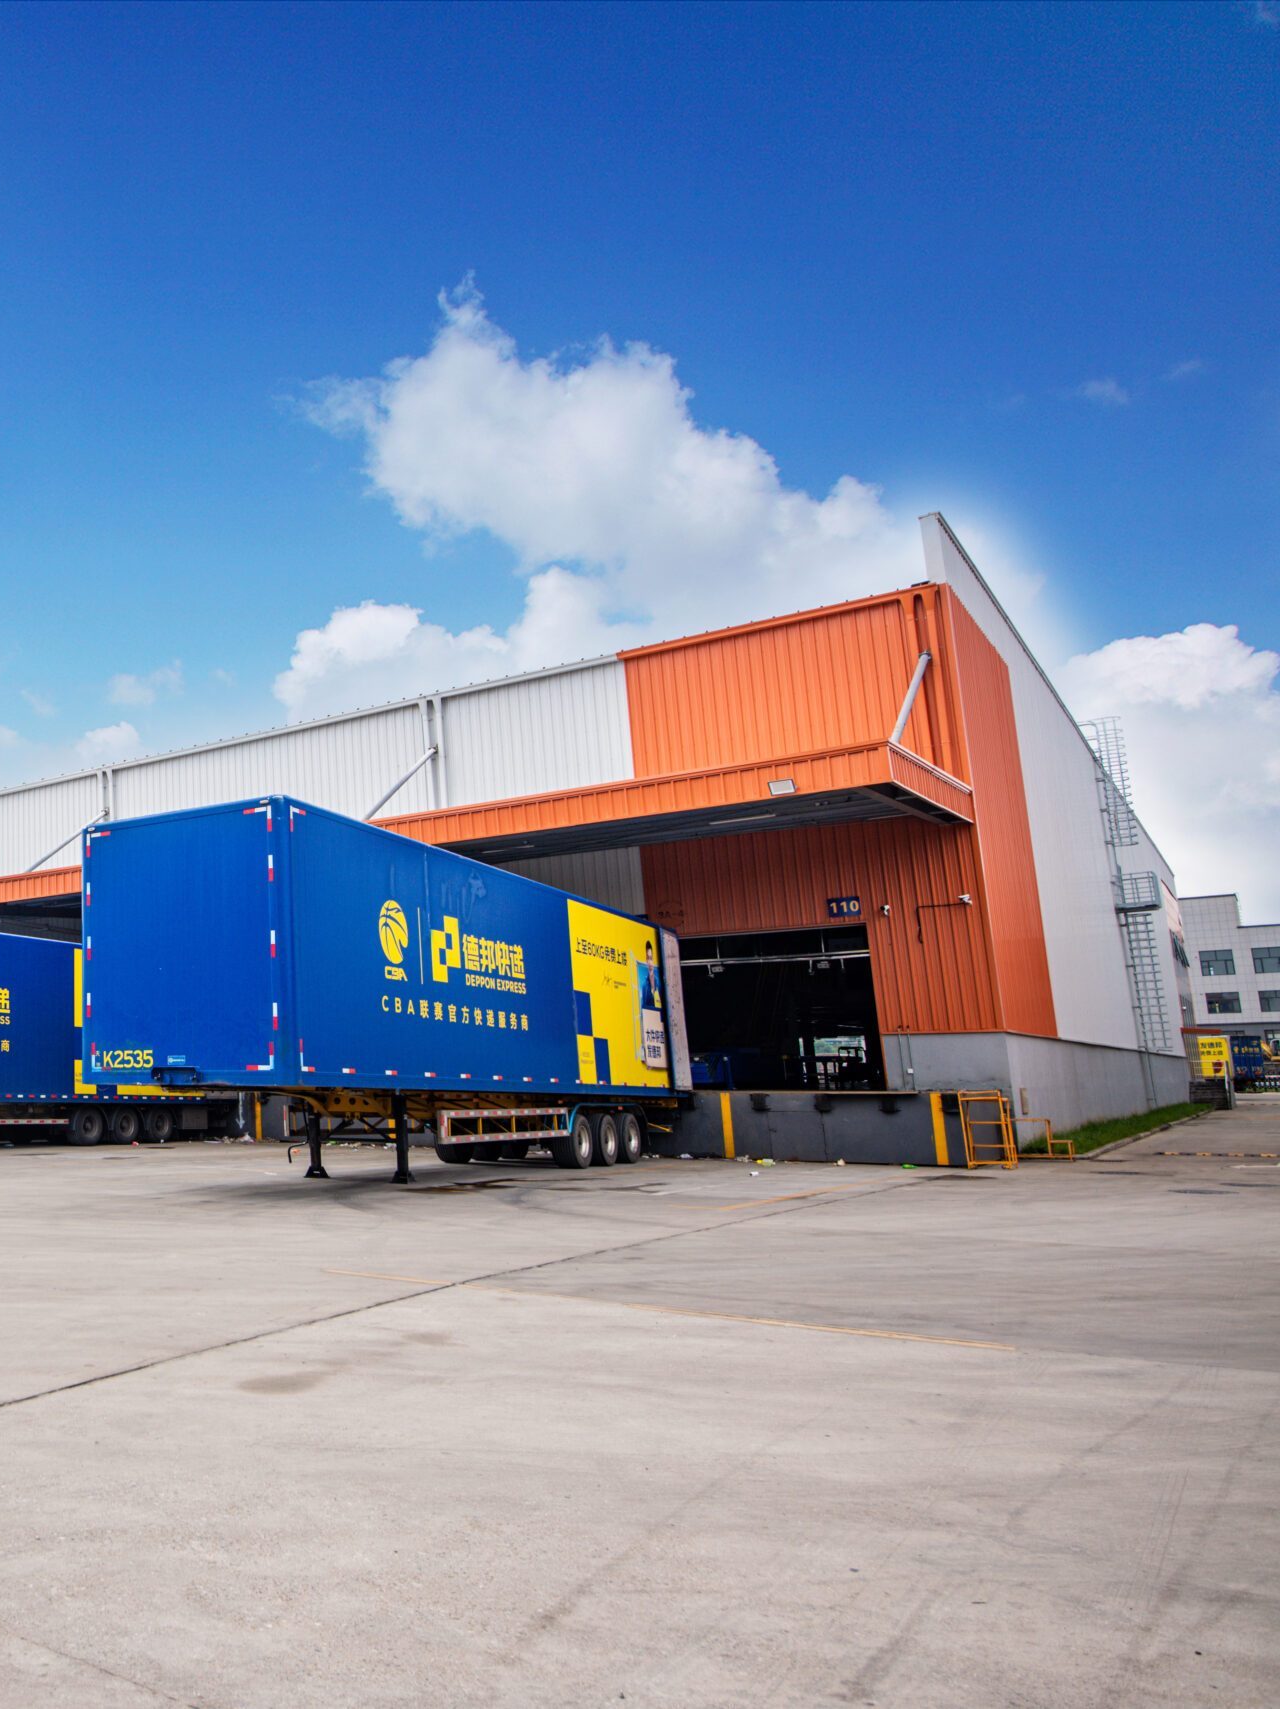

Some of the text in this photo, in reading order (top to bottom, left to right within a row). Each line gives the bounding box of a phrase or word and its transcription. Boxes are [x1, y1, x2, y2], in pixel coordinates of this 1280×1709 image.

[829, 900, 859, 914] 110
[462, 933, 525, 979] 德邦快递
[384, 965, 408, 982] CBA
[465, 973, 527, 995] DEPPON EXPRESS
[103, 1049, 154, 1069] K2535
